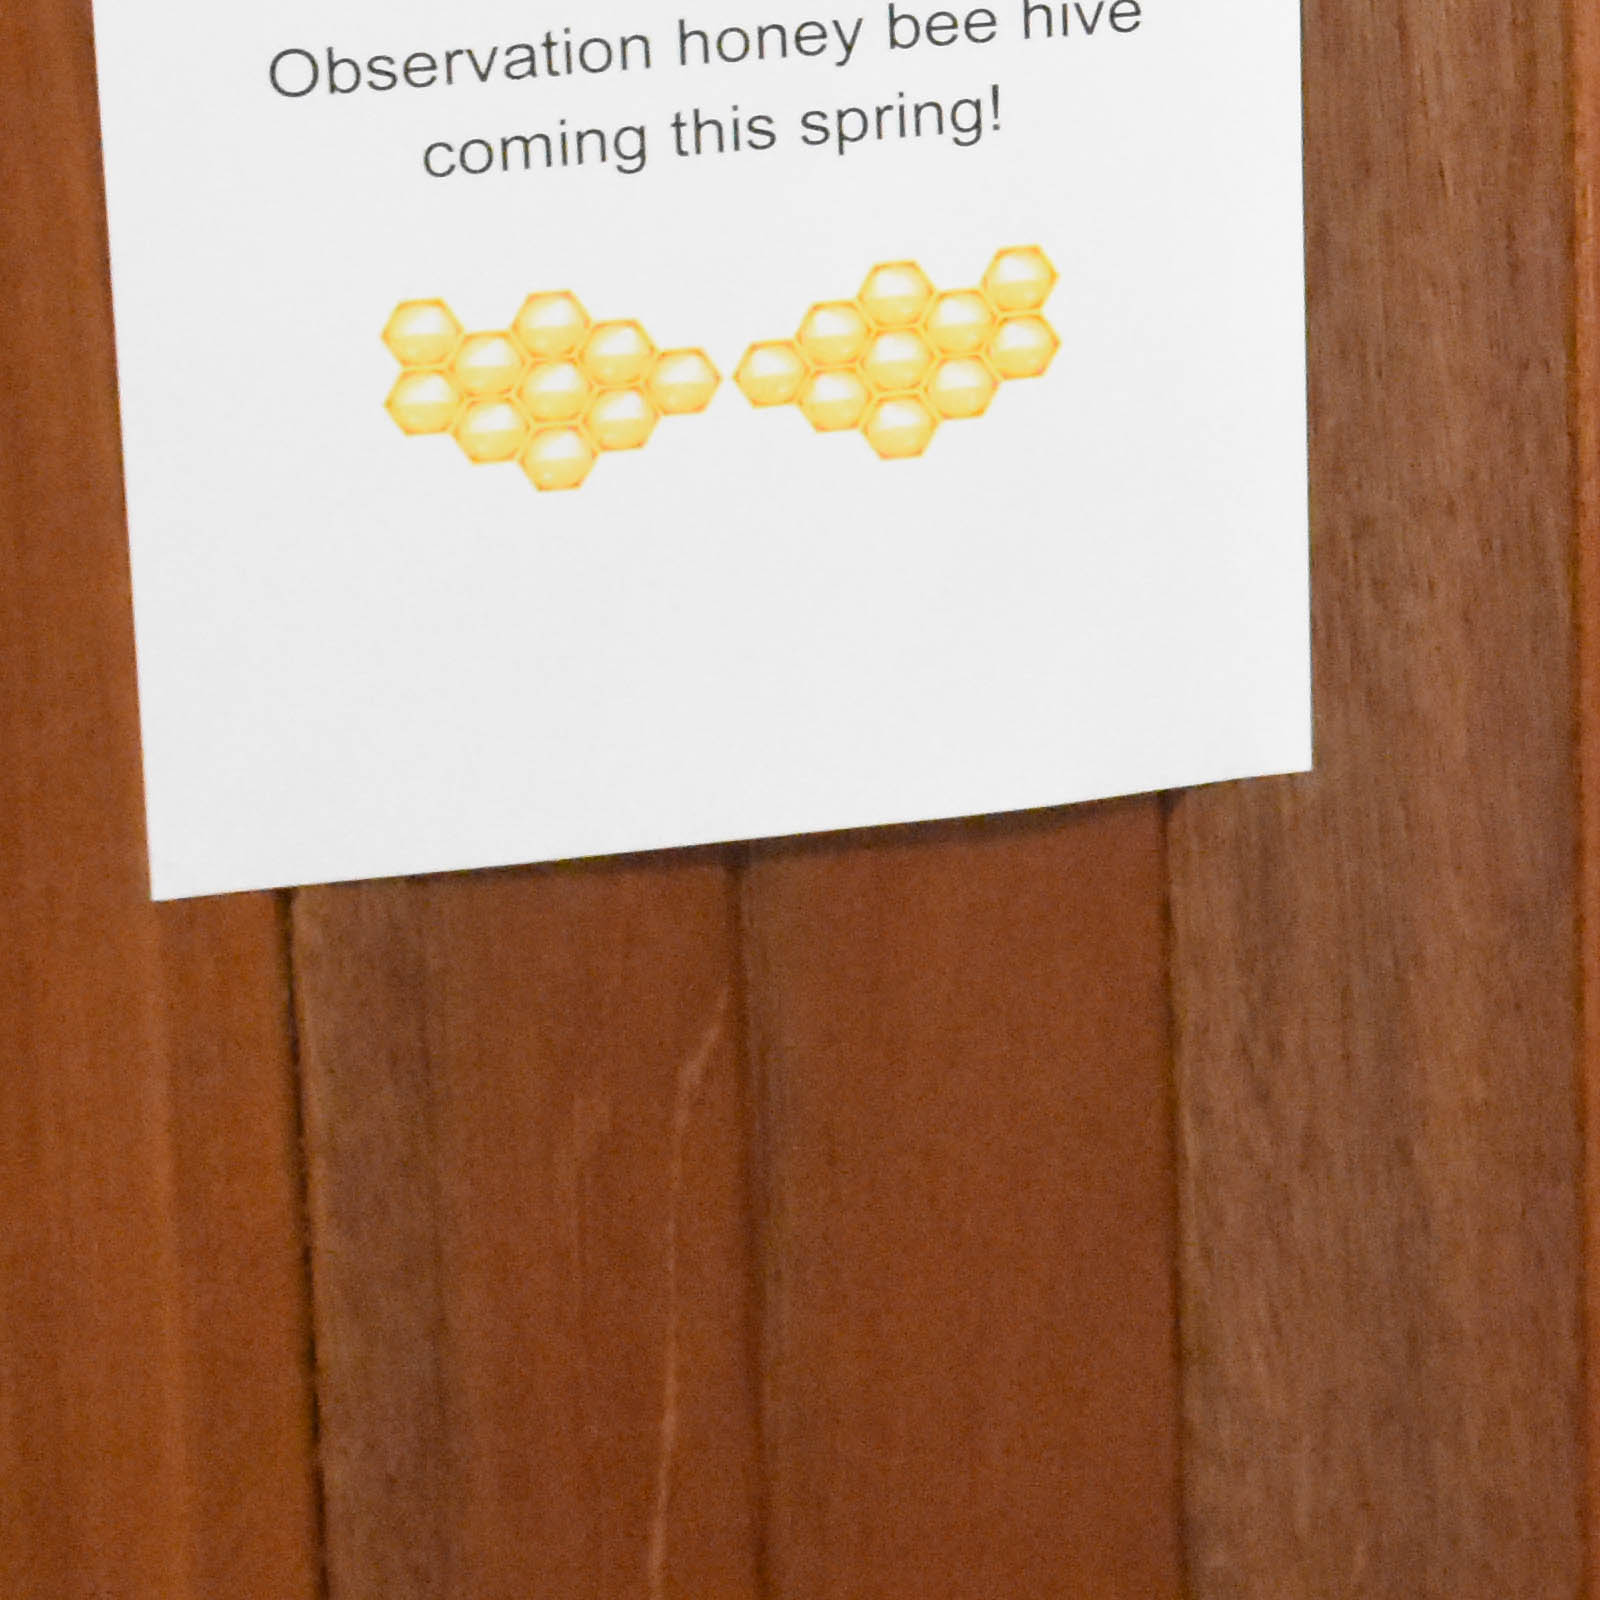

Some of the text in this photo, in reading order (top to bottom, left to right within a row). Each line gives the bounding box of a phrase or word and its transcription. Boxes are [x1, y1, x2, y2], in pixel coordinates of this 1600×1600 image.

[269, 27, 651, 98] Observation
[678, 17, 863, 67] honey
[888, 2, 997, 50] bee
[423, 83, 1001, 178] coming this spring!
